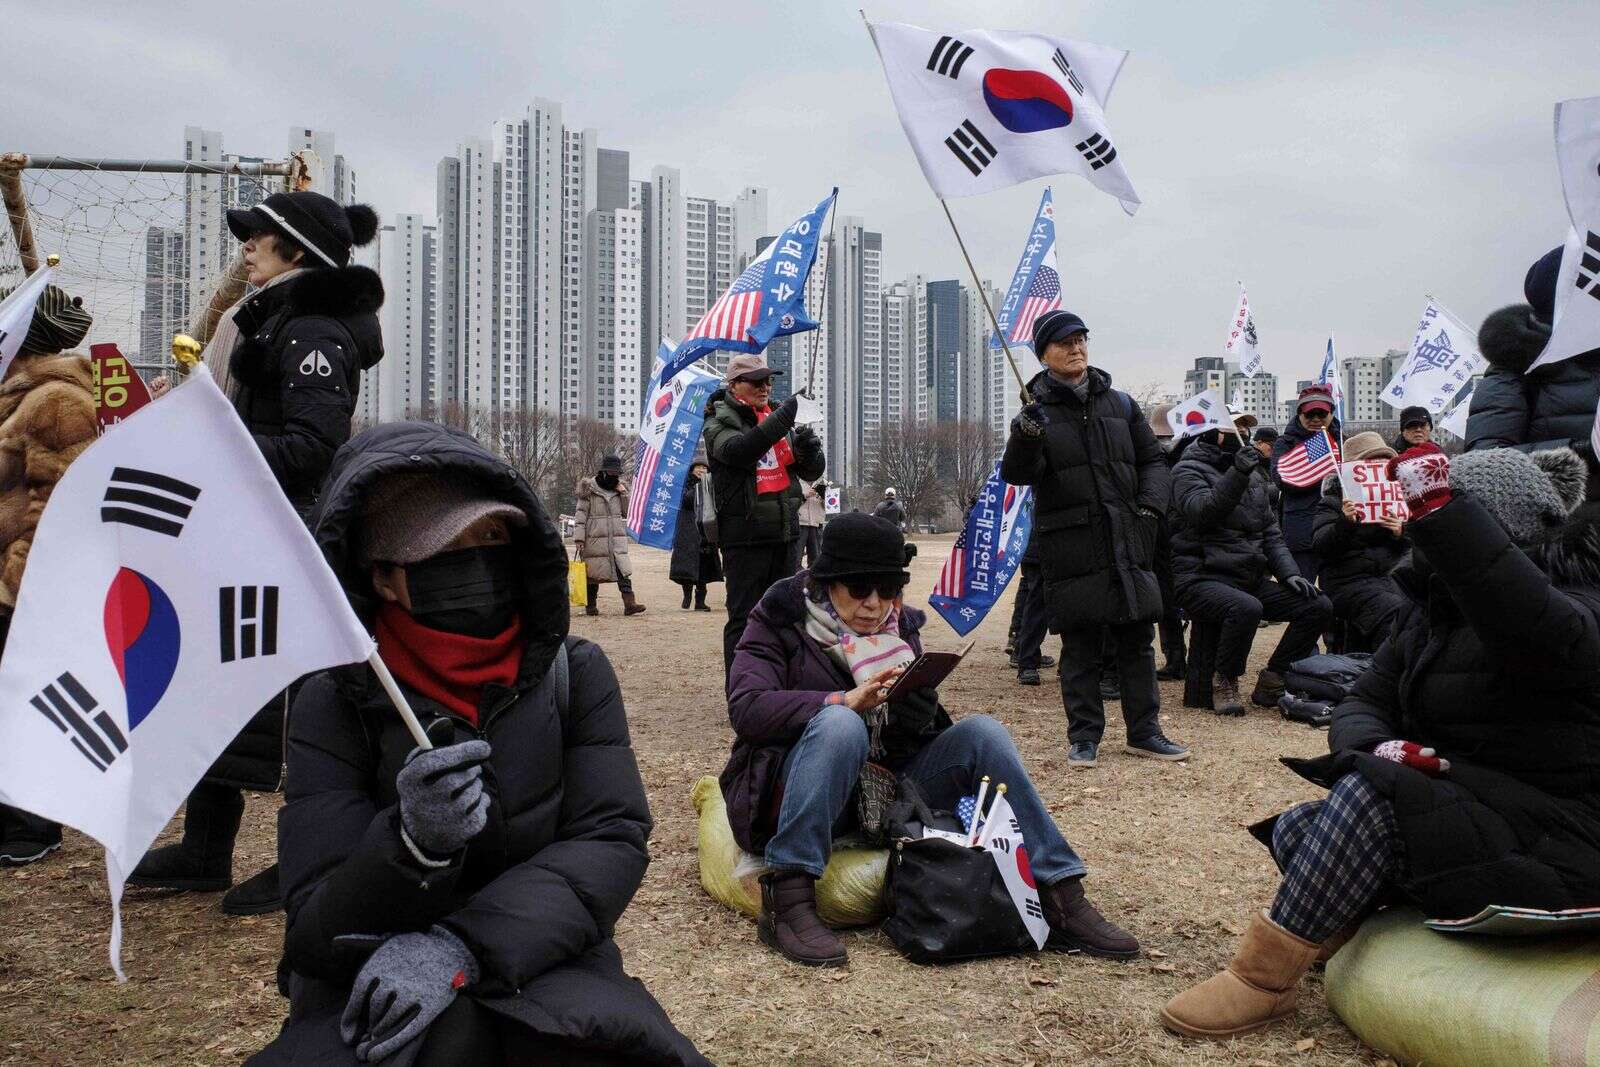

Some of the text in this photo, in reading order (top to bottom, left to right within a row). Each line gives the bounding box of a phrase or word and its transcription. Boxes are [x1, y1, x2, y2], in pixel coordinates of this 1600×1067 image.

[768, 220, 810, 316] 유대한수
[92, 358, 131, 408] 공
[1352, 464, 1389, 483] ST
[1363, 483, 1402, 501] THE
[1354, 502, 1408, 521] STEA
[970, 467, 1001, 592] 자유대한연대
